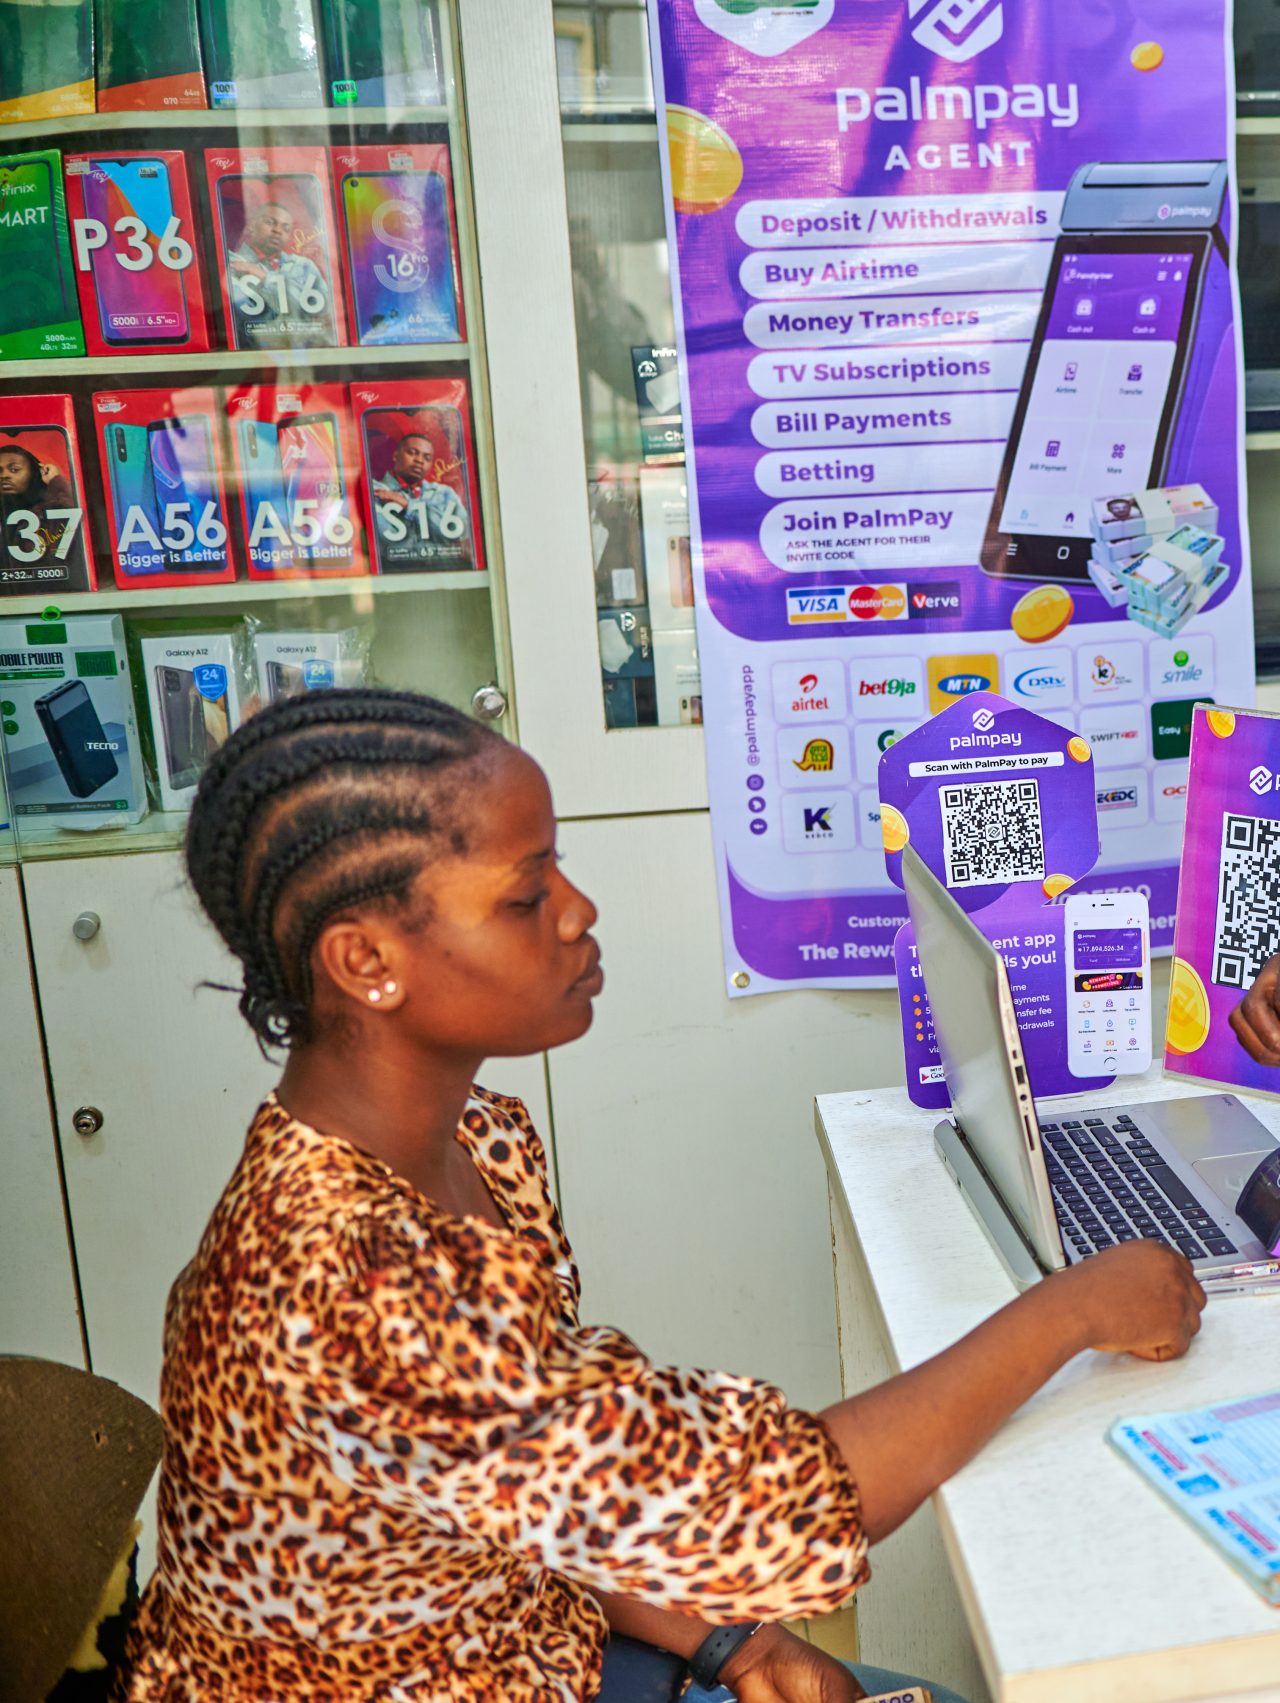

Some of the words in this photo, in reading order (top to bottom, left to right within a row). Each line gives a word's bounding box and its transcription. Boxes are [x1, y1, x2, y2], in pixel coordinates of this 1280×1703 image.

[835, 76, 1079, 132] palmpay
[884, 141, 1031, 171] AGENT
[0, 206, 48, 228] MART
[761, 210, 862, 237] Deposit
[882, 205, 1048, 231] Withdrawals
[73, 215, 193, 271] P36
[387, 253, 414, 277] 16
[411, 252, 428, 264] Pro
[765, 264, 814, 287] Buy
[821, 259, 919, 281] Airtime
[239, 274, 326, 316] S16
[769, 314, 853, 335] Money
[859, 307, 980, 329] Transfers
[652, 348, 676, 358] Infin
[773, 364, 807, 383] TV
[814, 356, 991, 383] Subscriptions
[776, 412, 818, 433] Bill
[825, 409, 952, 434] Payments
[780, 460, 875, 483] Betting
[1041, 465, 1067, 473] Payment
[117, 500, 227, 553] A56
[248, 499, 354, 547] A56
[382, 502, 464, 542] S16
[783, 511, 837, 532] Join
[843, 508, 953, 531] PalmPay
[6, 508, 83, 563] 37
[786, 540, 809, 550] ASK
[811, 539, 832, 549] THE
[836, 537, 872, 549] AGENT
[875, 536, 896, 546] FOR
[899, 535, 930, 545] THEIR
[118, 552, 166, 567] Bigger
[169, 550, 180, 562] is
[185, 549, 226, 561] Better
[249, 548, 294, 563] Bigger
[297, 546, 308, 558] is
[313, 545, 352, 559] Better
[786, 552, 822, 563] INVITE
[825, 551, 855, 561] CODE
[798, 598, 838, 612] VISA
[850, 597, 904, 609] MasterCard
[913, 595, 959, 609] Verve
[28, 652, 64, 665] POWER
[196, 648, 208, 656] A12
[276, 646, 304, 654] Galaxy
[202, 668, 218, 680] 24
[311, 665, 325, 676] 24
[1161, 665, 1202, 684] smile
[859, 679, 916, 697] bet9ja
[947, 678, 981, 692] MTN
[792, 697, 829, 711] airtel
[742, 665, 760, 766] @palmpayapp
[1158, 726, 1181, 736] Easy
[87, 742, 119, 750] TECNO
[950, 732, 1022, 750] palmpay
[925, 764, 949, 773] Scan
[950, 761, 973, 770] with
[975, 758, 1016, 769] PalmPay
[1019, 757, 1029, 765] to
[1031, 756, 1048, 768] pay
[992, 936, 1020, 950] ent
[1025, 934, 1056, 949] app
[798, 944, 839, 961] The
[843, 942, 895, 959] Rewa
[1022, 951, 1056, 969] you!
[1014, 995, 1050, 1005] ayments
[1017, 1008, 1037, 1018] nsfer
